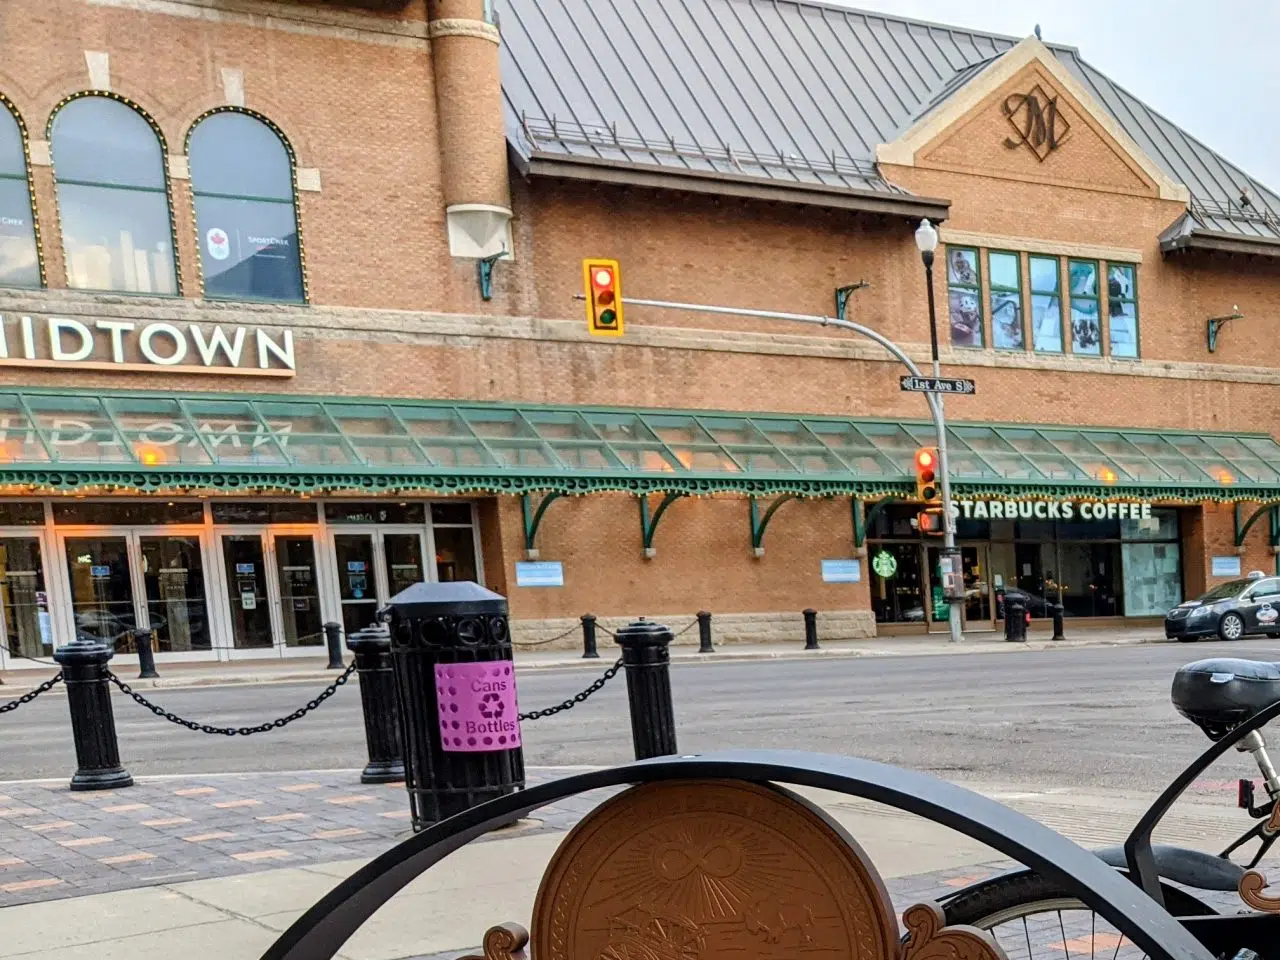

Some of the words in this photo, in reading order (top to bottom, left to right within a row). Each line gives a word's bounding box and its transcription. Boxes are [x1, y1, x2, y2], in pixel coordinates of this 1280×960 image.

[0, 315, 296, 369] IDTOWN
[915, 379, 930, 390] 1st
[934, 380, 952, 391] Ave
[955, 381, 964, 392] S
[949, 500, 1073, 519] STARBUCKS
[1080, 502, 1152, 520] COFFEE
[470, 680, 507, 693] Cans
[465, 719, 516, 734] Bottles
